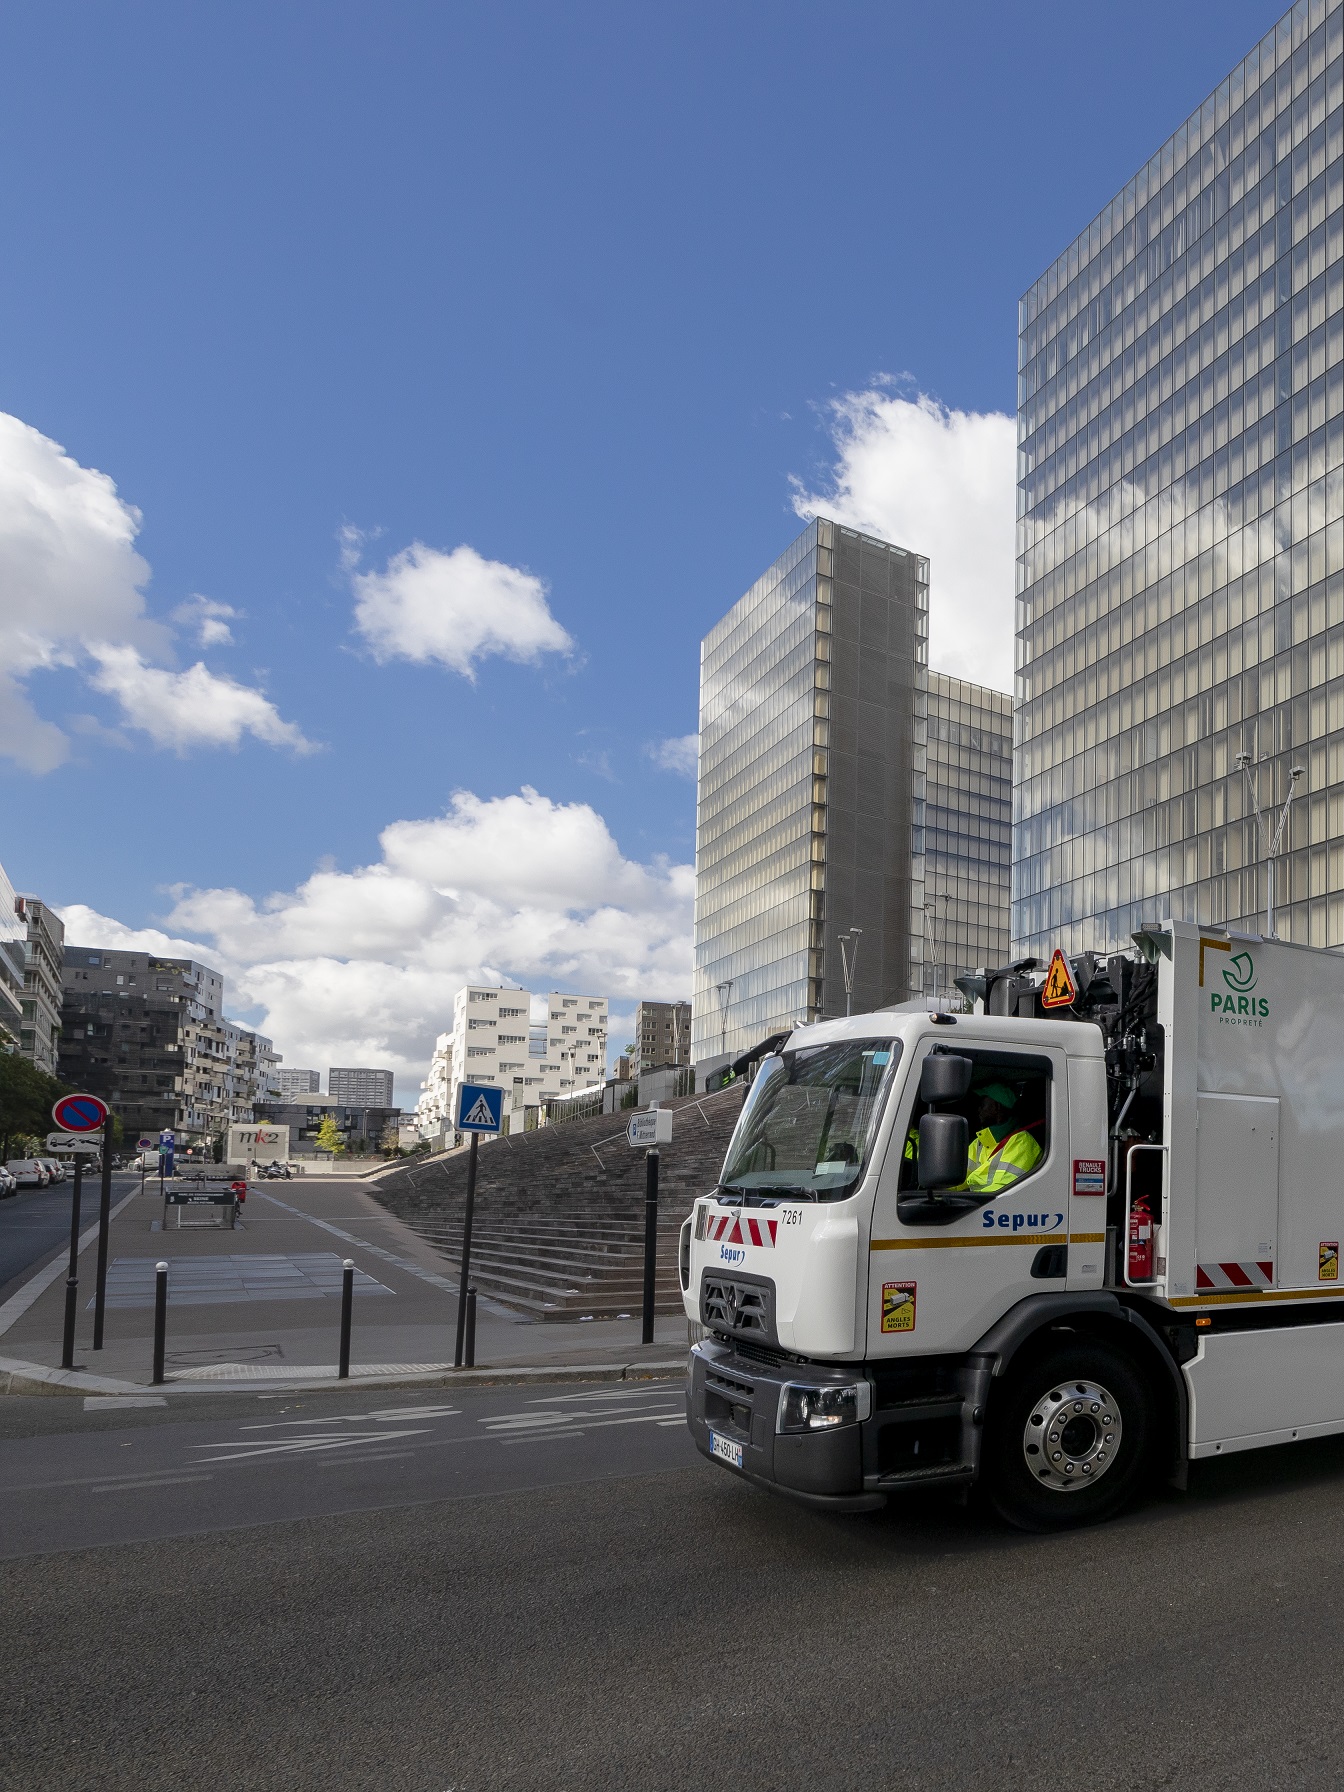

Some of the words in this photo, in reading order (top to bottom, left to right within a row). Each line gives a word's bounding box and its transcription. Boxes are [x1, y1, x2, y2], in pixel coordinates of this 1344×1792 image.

[1210, 993, 1269, 1017] PARIS
[1219, 1017, 1262, 1027] PROPRETÉ
[240, 1129, 279, 1144] mk2
[781, 1210, 802, 1225] 7261
[982, 1210, 1050, 1231] Sepur
[720, 1244, 741, 1263] Sepur
